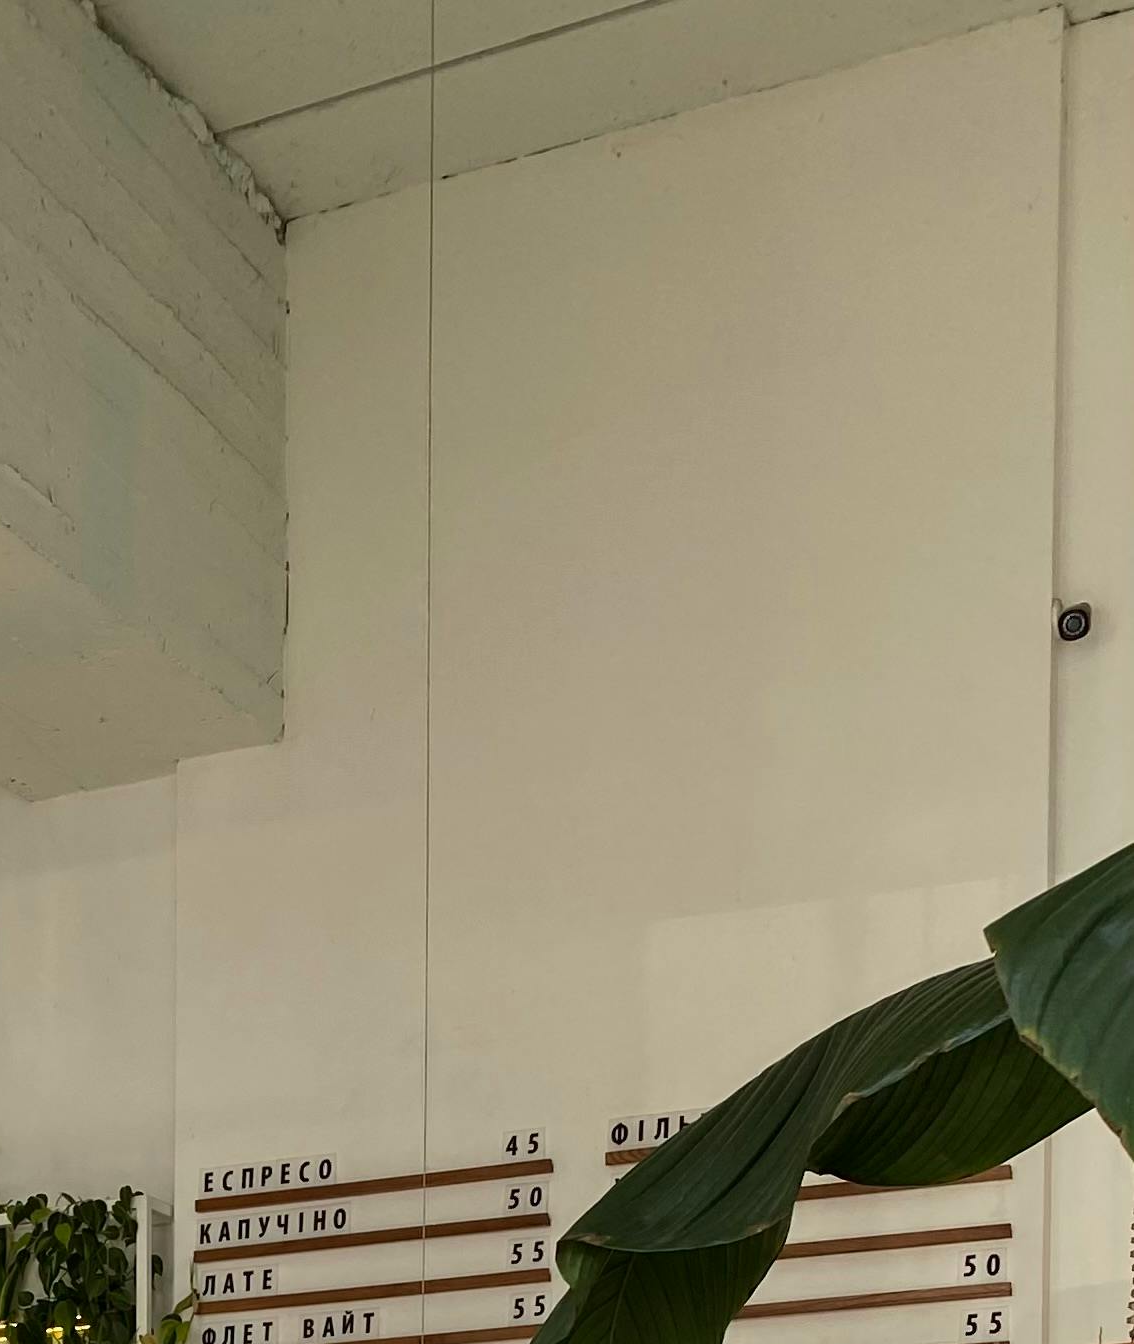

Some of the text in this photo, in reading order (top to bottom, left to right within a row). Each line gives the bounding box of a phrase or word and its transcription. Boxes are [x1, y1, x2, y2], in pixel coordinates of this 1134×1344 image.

[611, 1115, 692, 1145] ФІЛЬ
[203, 1132, 539, 1193] ЕСПРЕСО 45
[199, 1186, 543, 1245] КАПУЧІНО 50
[202, 1240, 545, 1297] ЛАТЕ 55
[963, 1253, 1001, 1277] 50
[302, 1310, 375, 1339] ВАЙТ
[513, 1294, 546, 1320] 55
[965, 1311, 1002, 1337] 55
